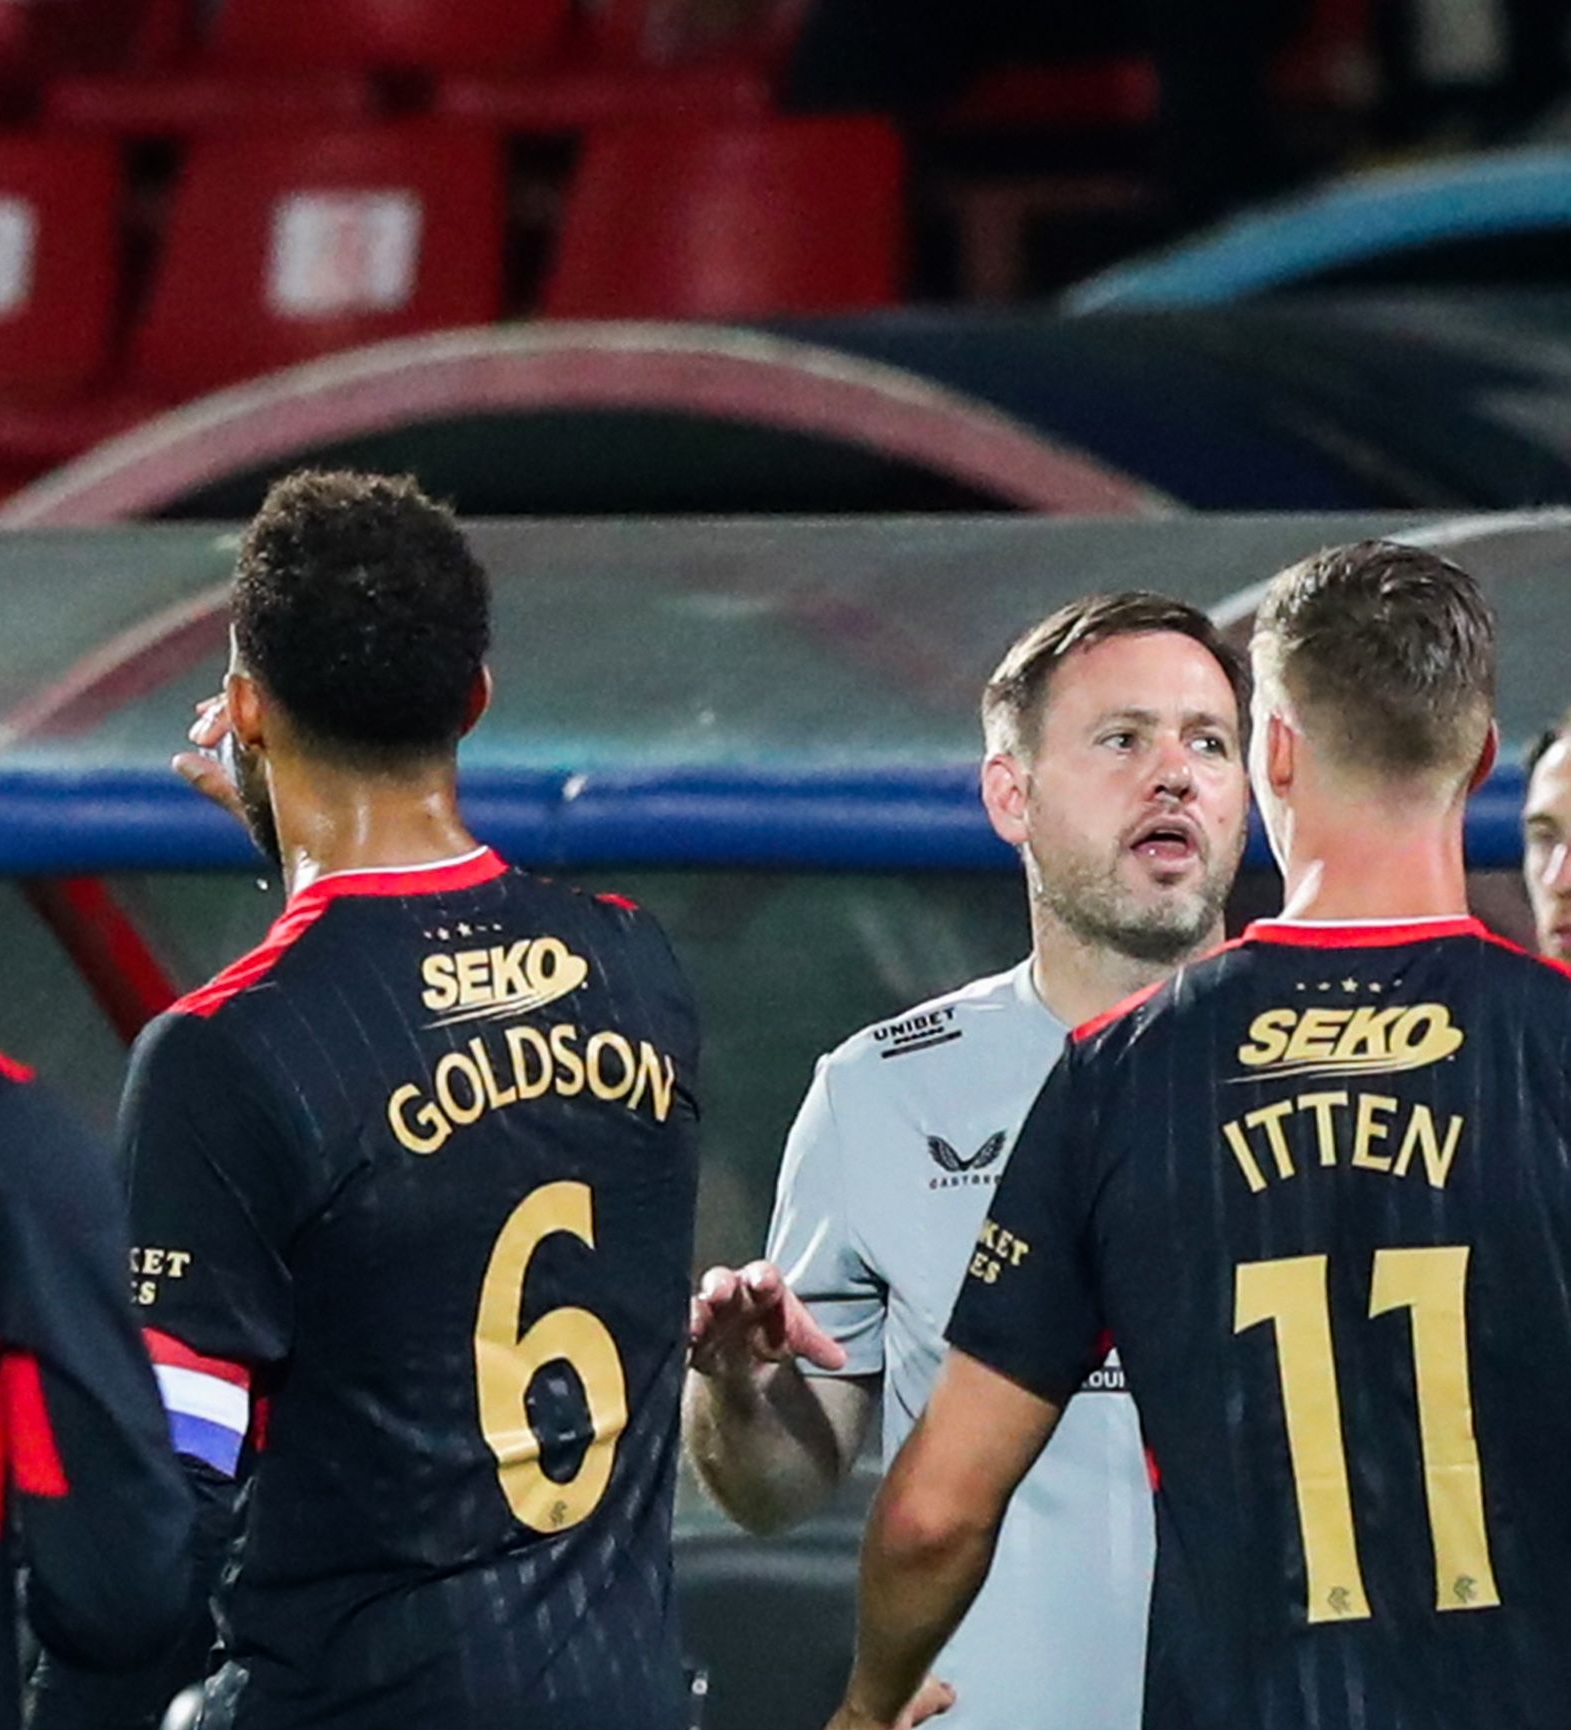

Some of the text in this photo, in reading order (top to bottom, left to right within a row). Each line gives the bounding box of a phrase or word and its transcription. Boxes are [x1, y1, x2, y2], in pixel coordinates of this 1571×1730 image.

[421, 936, 588, 1013] SEKO
[873, 1006, 956, 1042] UNIBET
[1238, 1001, 1464, 1072] SEKO
[386, 1025, 675, 1156] GOLDSON
[1221, 1090, 1464, 1193] ITTEN
[474, 1180, 629, 1534] 6
[1233, 1244, 1502, 1624] 11
